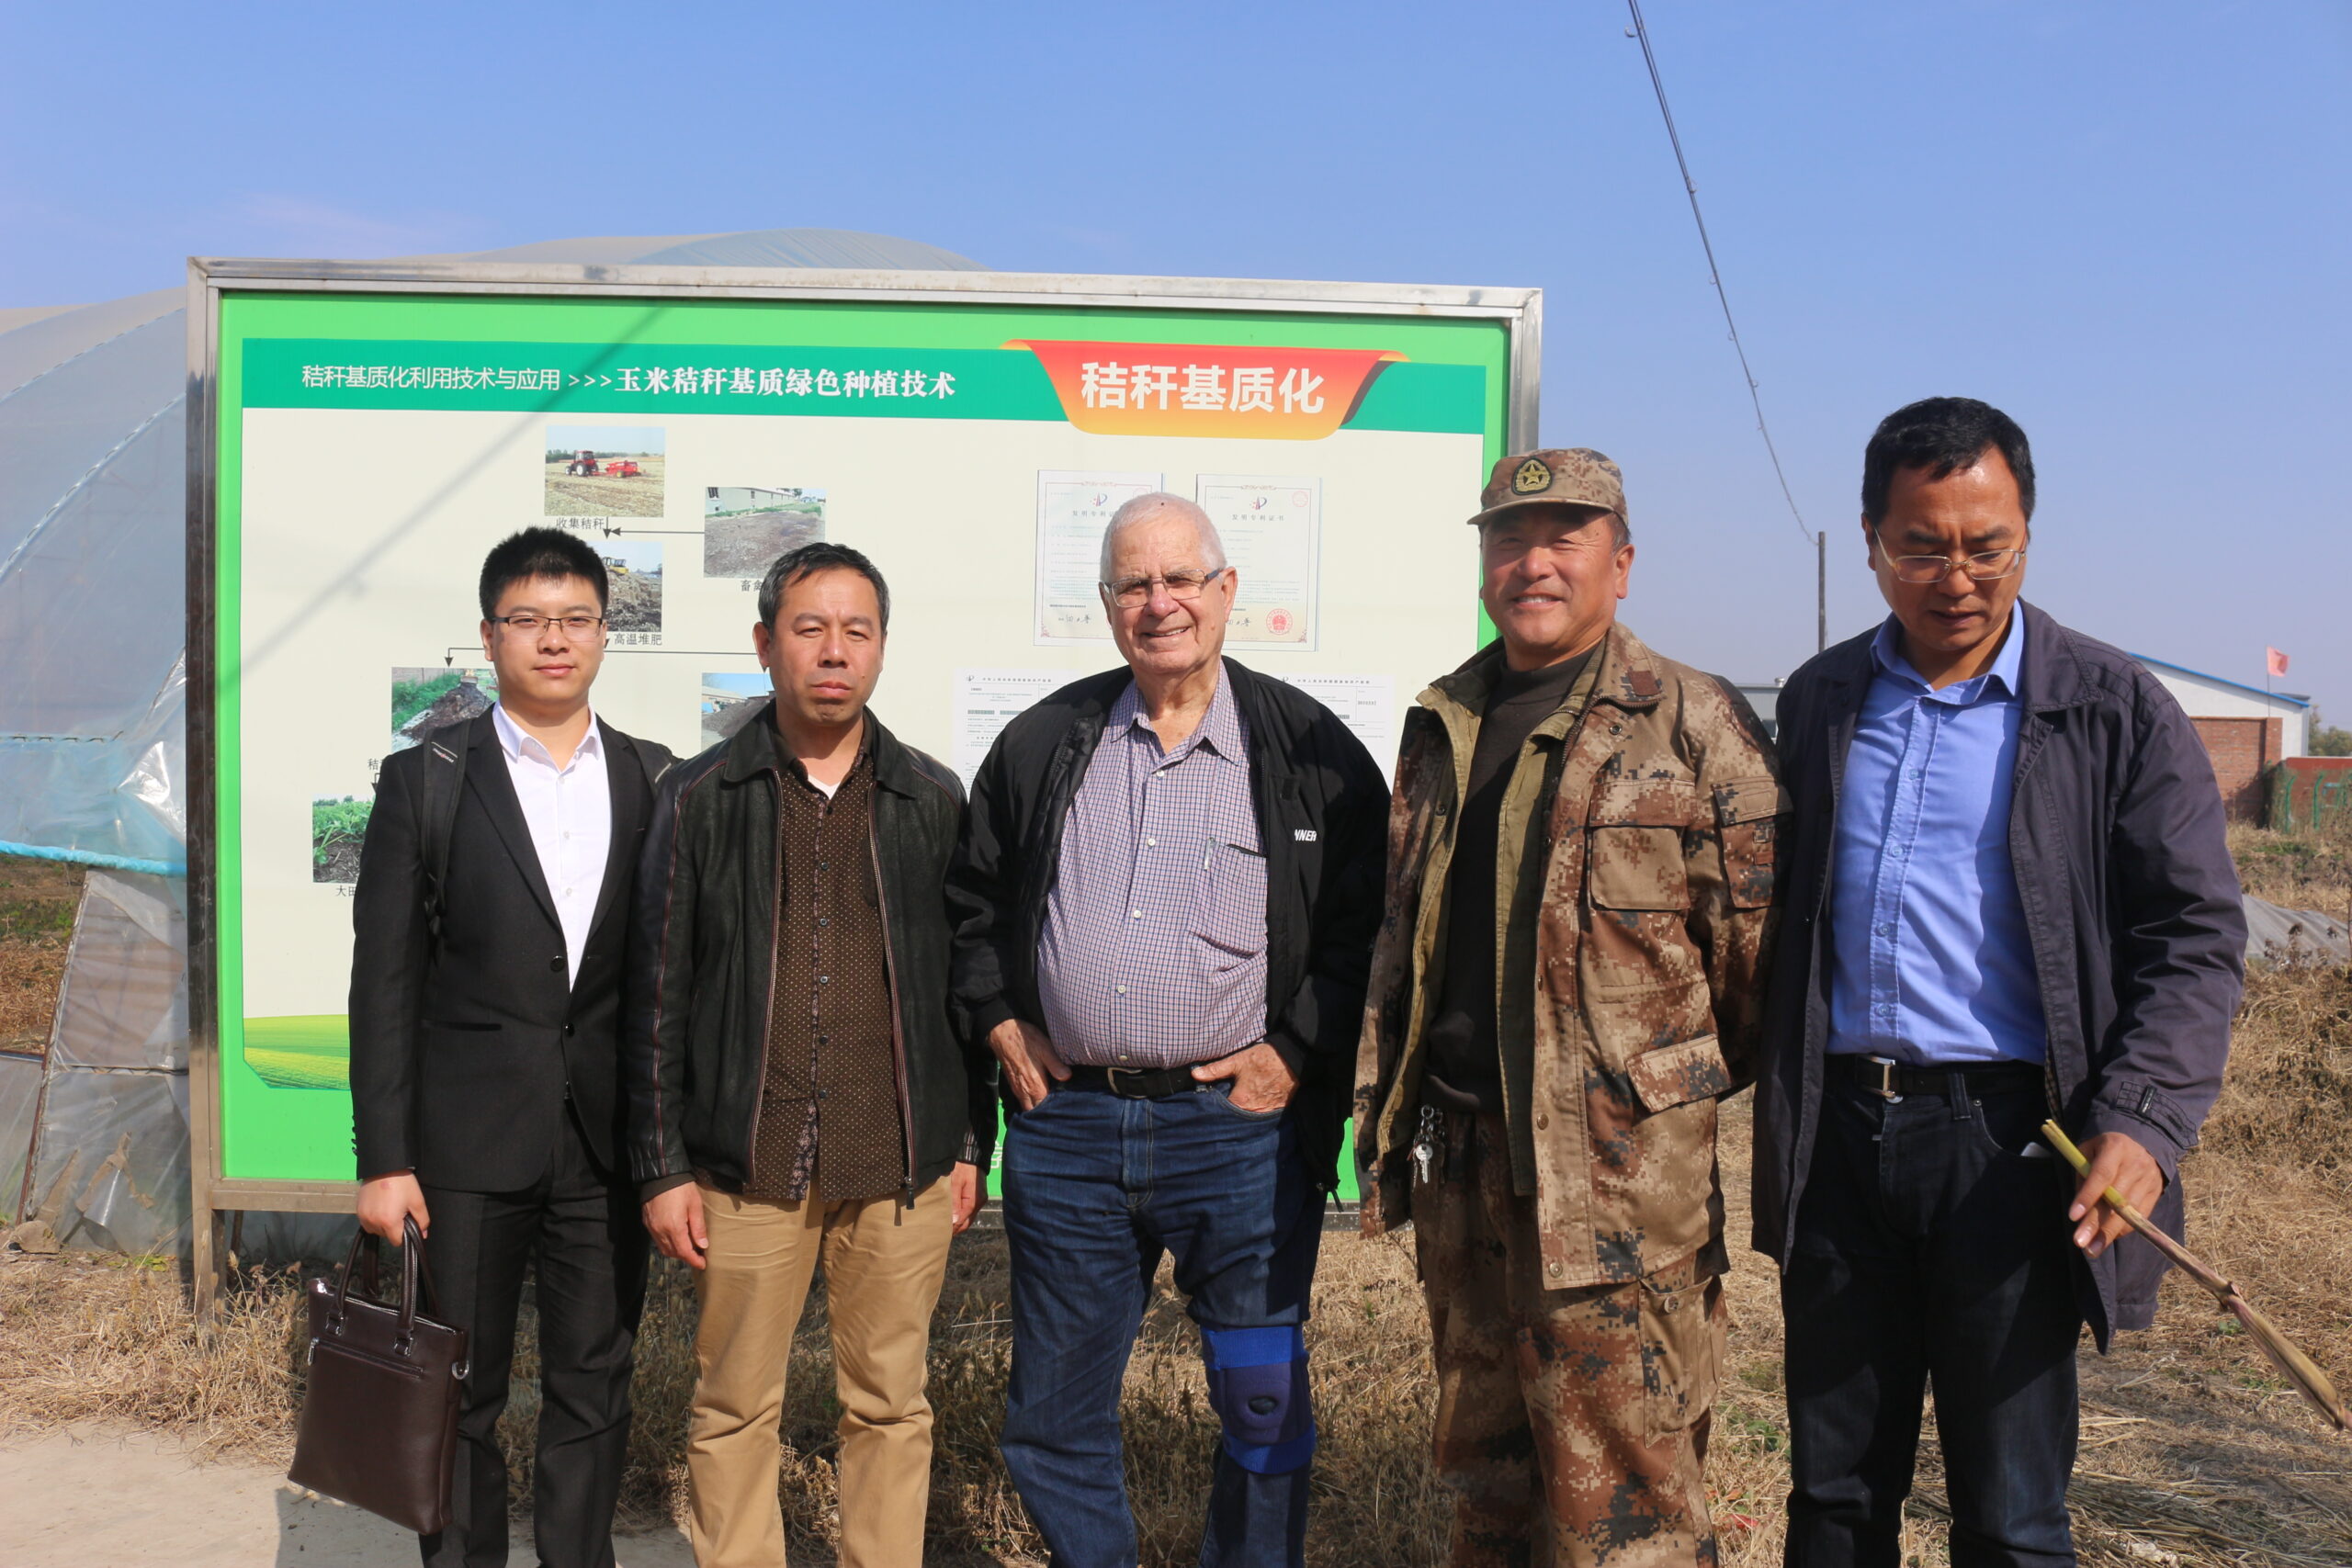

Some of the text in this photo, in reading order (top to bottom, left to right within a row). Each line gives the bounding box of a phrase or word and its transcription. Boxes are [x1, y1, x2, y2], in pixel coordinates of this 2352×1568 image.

[302, 365, 956, 399] 秸秆基质化利用技术与应用 玉米秸秆基质绿色种植技术
[1080, 361, 1325, 413] 秸秆基质化
[556, 517, 605, 530] 收集秸秆
[614, 633, 662, 646] 高温堆肥
